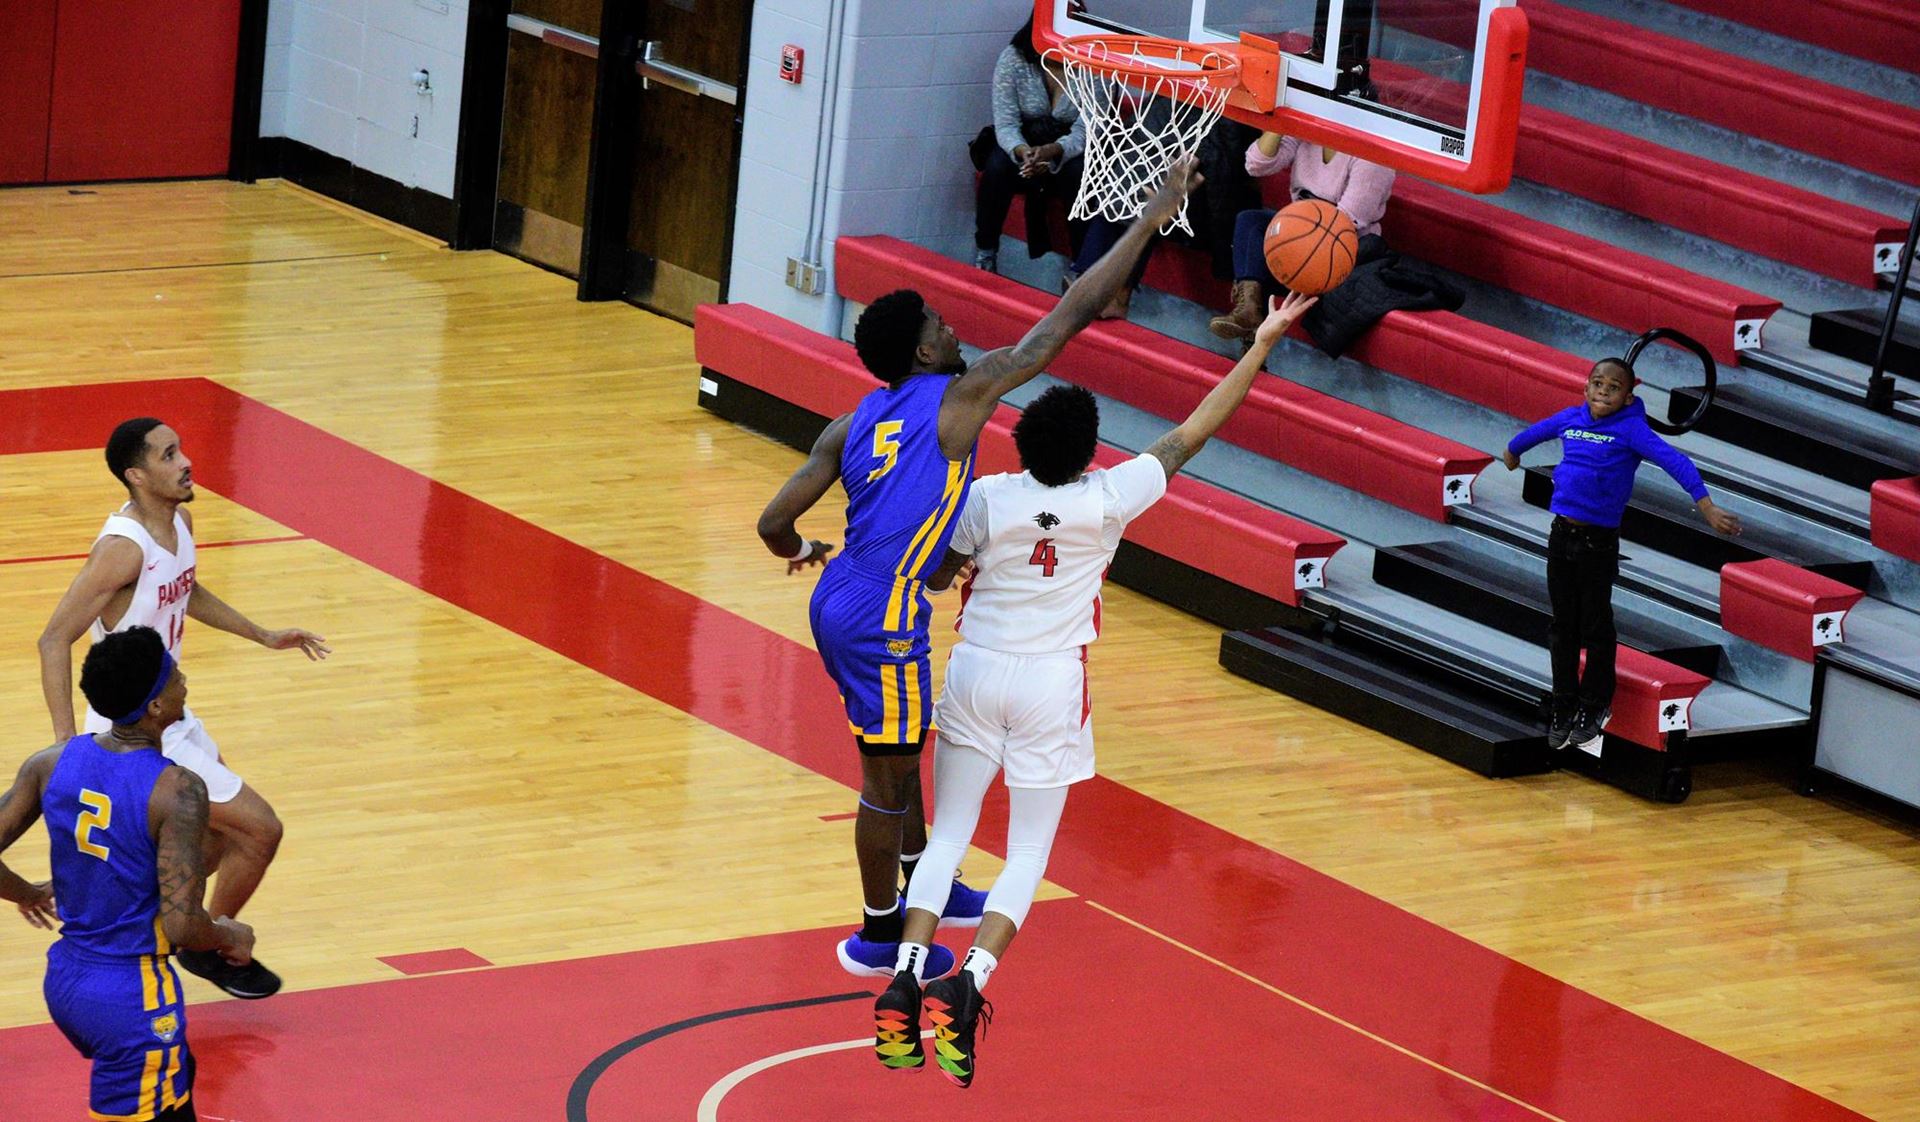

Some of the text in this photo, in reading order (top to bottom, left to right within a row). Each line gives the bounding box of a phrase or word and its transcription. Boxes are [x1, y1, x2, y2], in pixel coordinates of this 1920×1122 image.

[867, 419, 904, 483] 5
[1582, 431, 1615, 442] SPORT
[1029, 538, 1058, 577] 4
[75, 788, 111, 861] 2
